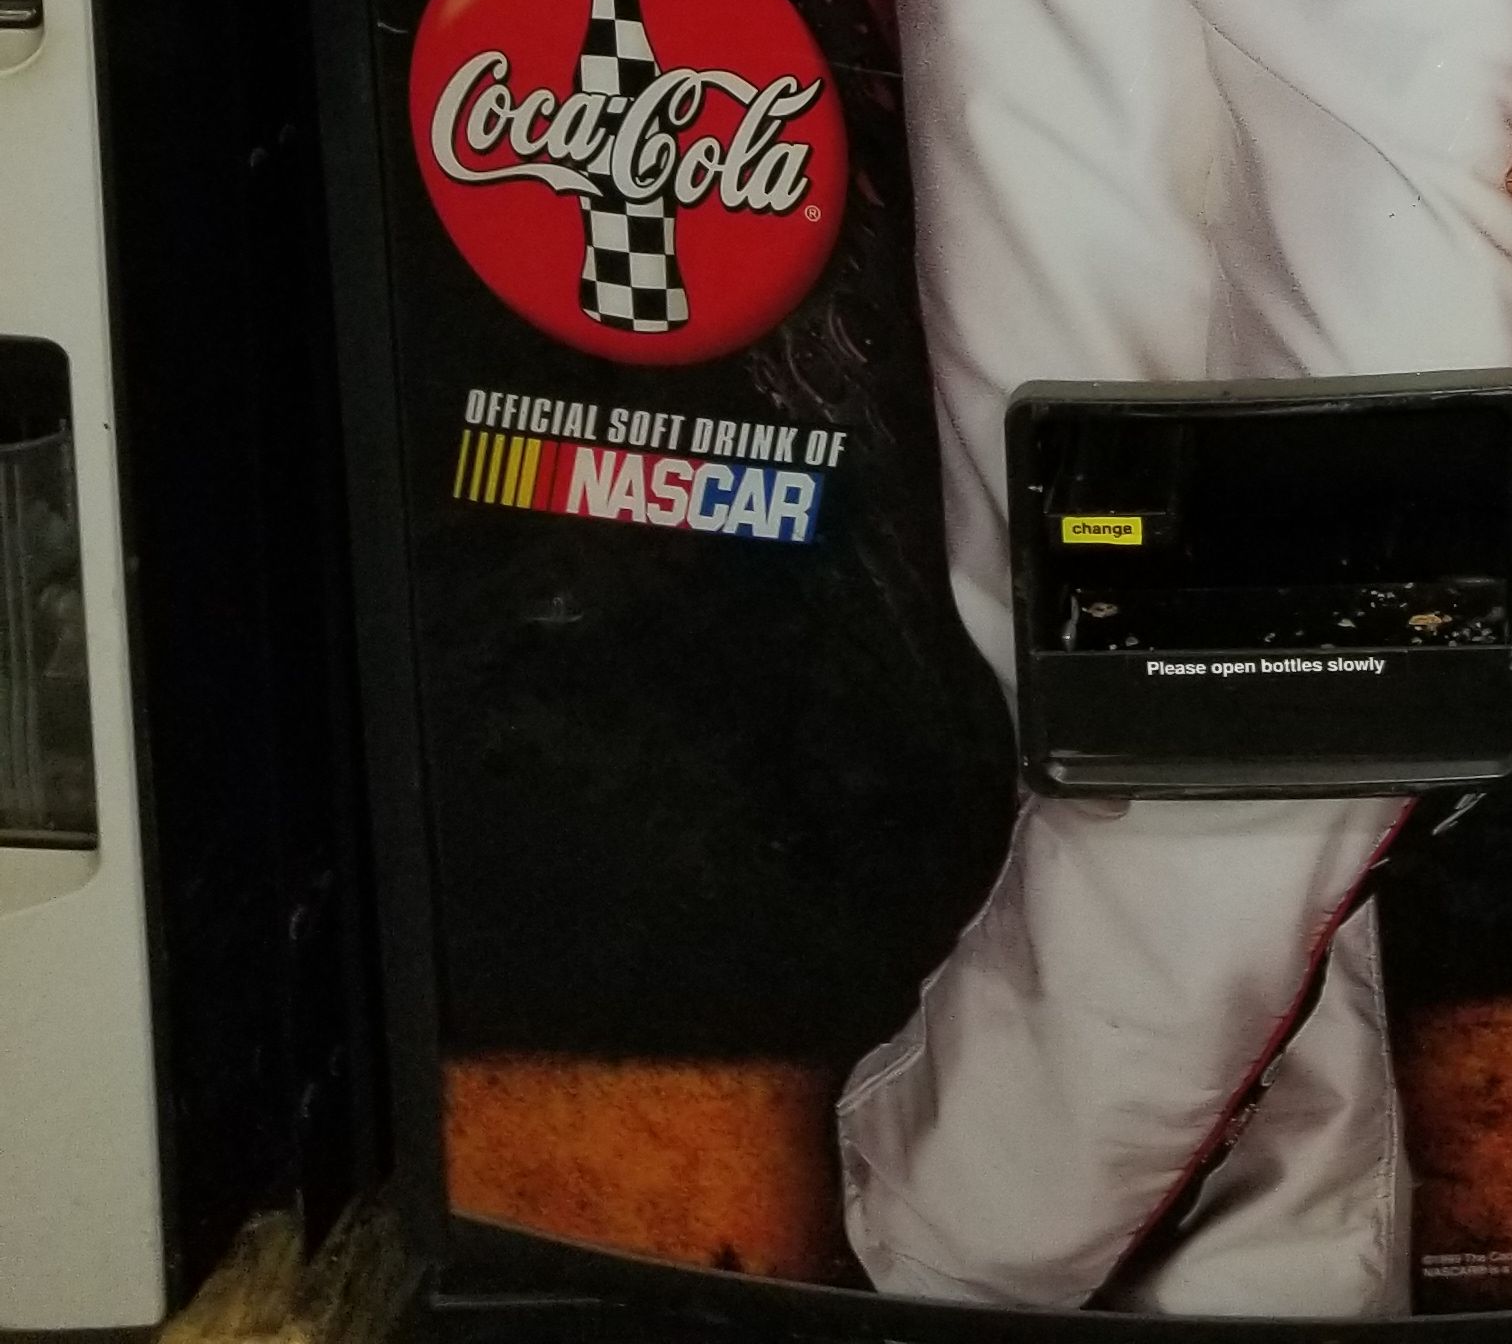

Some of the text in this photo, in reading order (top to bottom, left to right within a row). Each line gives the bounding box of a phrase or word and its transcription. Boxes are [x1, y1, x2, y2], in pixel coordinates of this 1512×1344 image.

[431, 50, 822, 211] Coca-Cola
[466, 389, 848, 469] OFFICIAL SOFT DRINK OF
[565, 448, 816, 542] NASCAR
[1072, 520, 1133, 539] change
[1147, 656, 1385, 678] Please open bottles slowly
